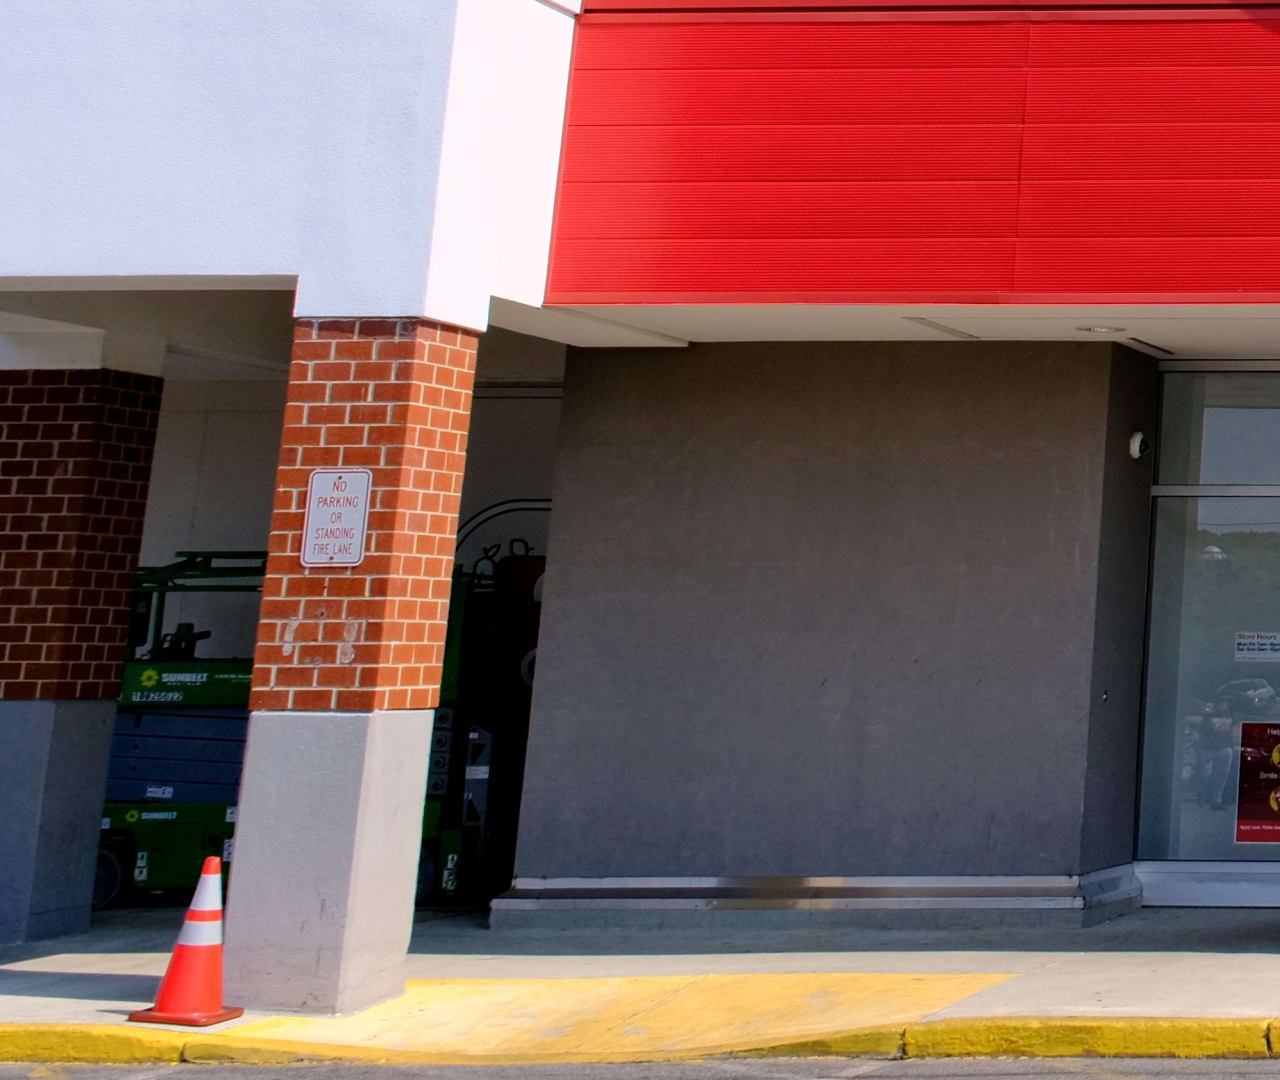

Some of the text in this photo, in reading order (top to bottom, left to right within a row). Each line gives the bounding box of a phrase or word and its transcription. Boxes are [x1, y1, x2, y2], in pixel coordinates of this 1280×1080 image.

[332, 480, 347, 492] NO
[317, 496, 359, 508] PARKING
[330, 512, 343, 524] OR
[315, 527, 355, 540] STANDING
[312, 542, 353, 556] FIRE LANE
[161, 672, 208, 682] SUNBELT
